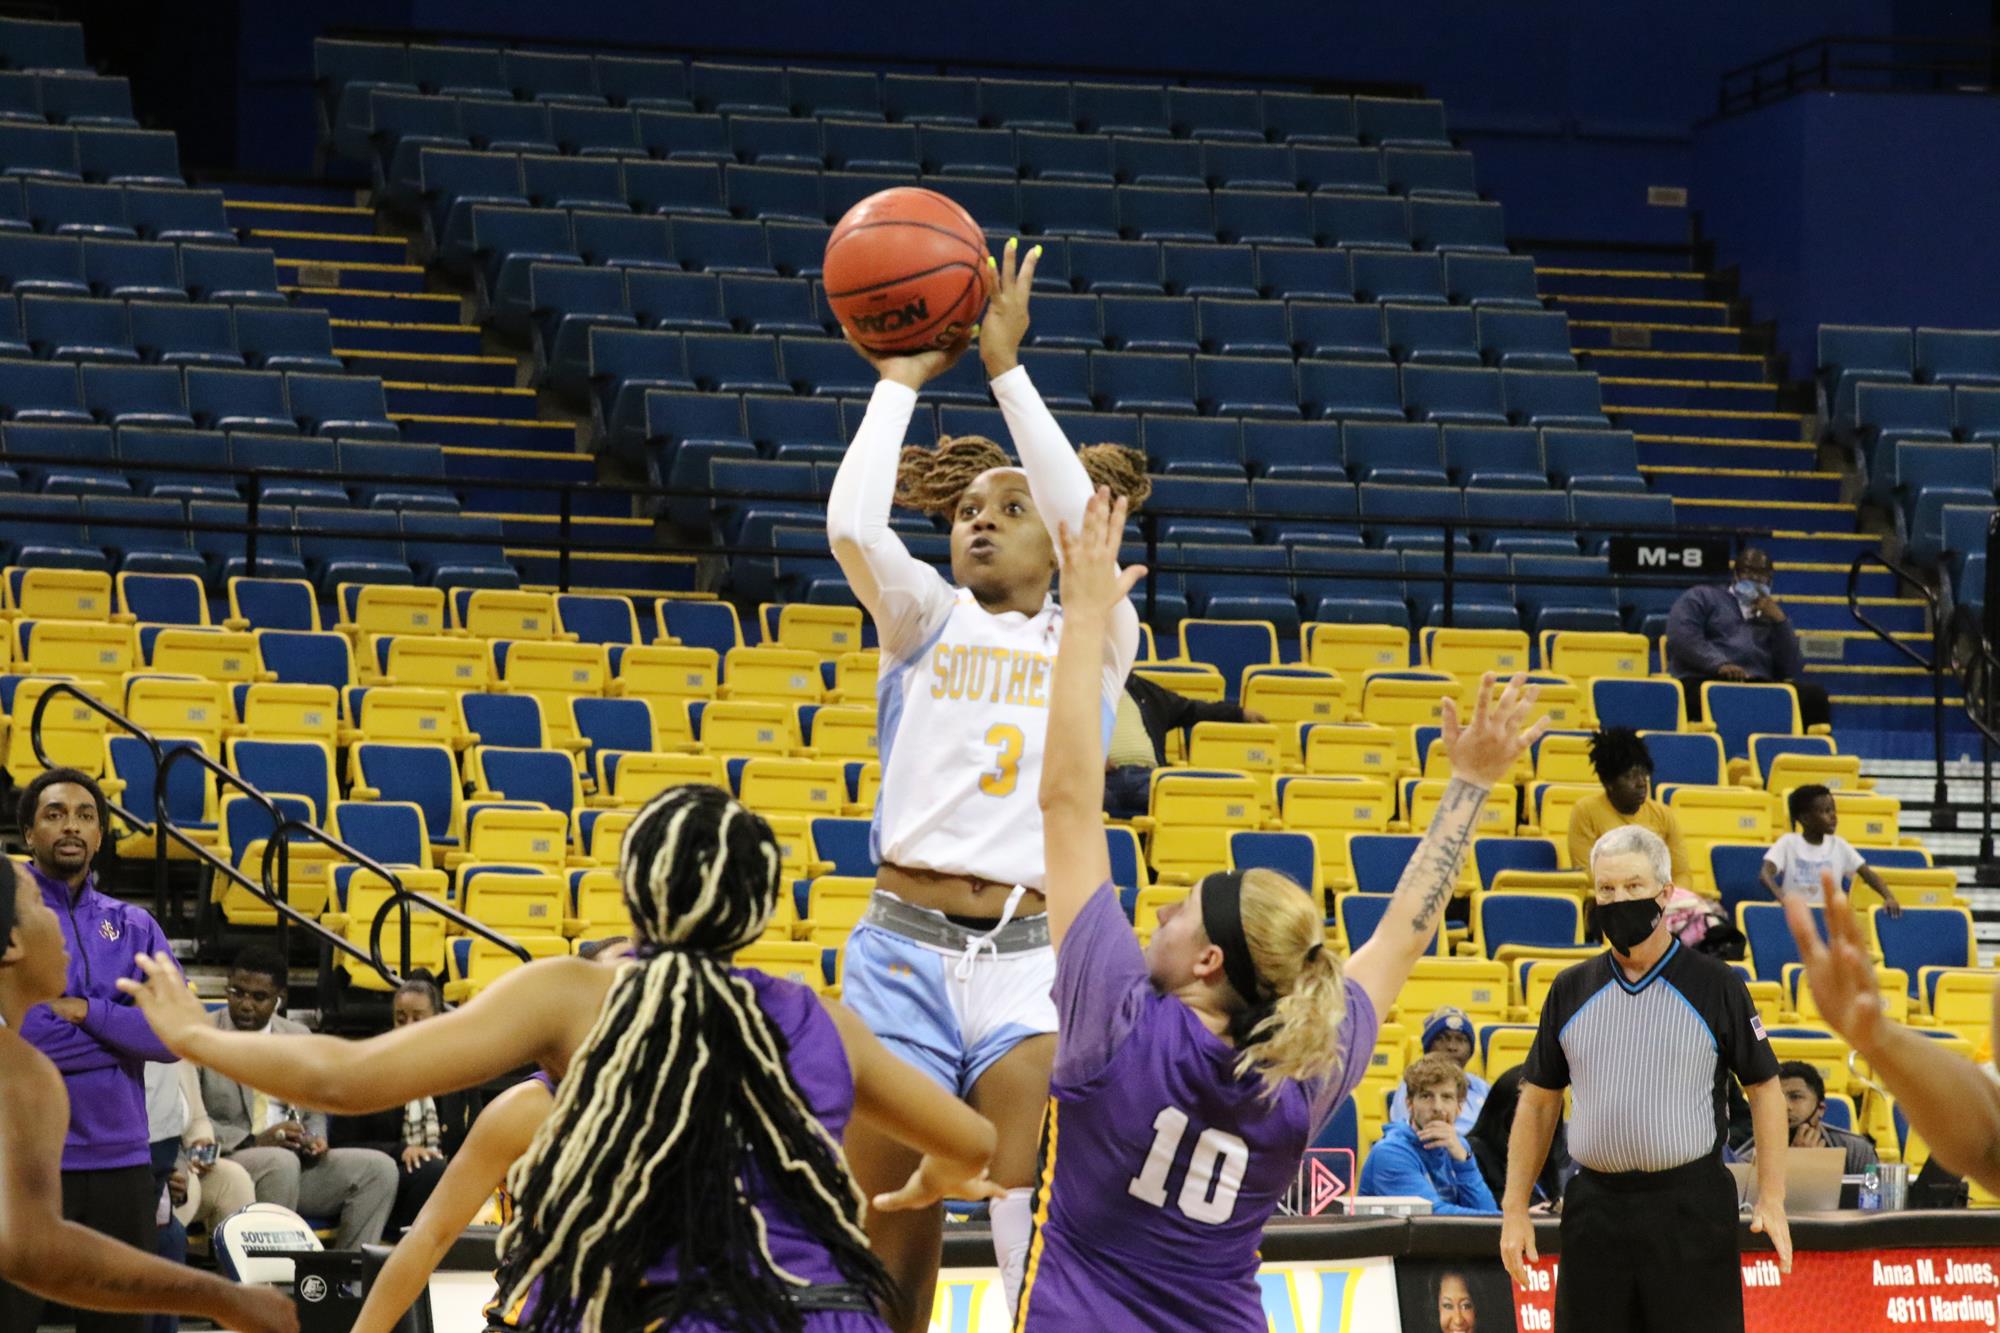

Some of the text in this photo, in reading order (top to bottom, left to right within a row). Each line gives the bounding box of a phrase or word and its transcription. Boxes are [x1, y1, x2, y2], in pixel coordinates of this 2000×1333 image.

[849, 296, 929, 334] NCAA
[1637, 547, 1703, 567] M-8
[931, 643, 1056, 708] SOUTHE
[978, 722, 1025, 798] 3
[1127, 1105, 1249, 1226] 10
[1742, 1259, 1781, 1287] with
[1873, 1258, 1999, 1288] Anna M. Jones,
[1520, 1303, 1552, 1331] the
[1887, 1296, 1927, 1323] 4811
[1930, 1294, 1996, 1326] Harding
